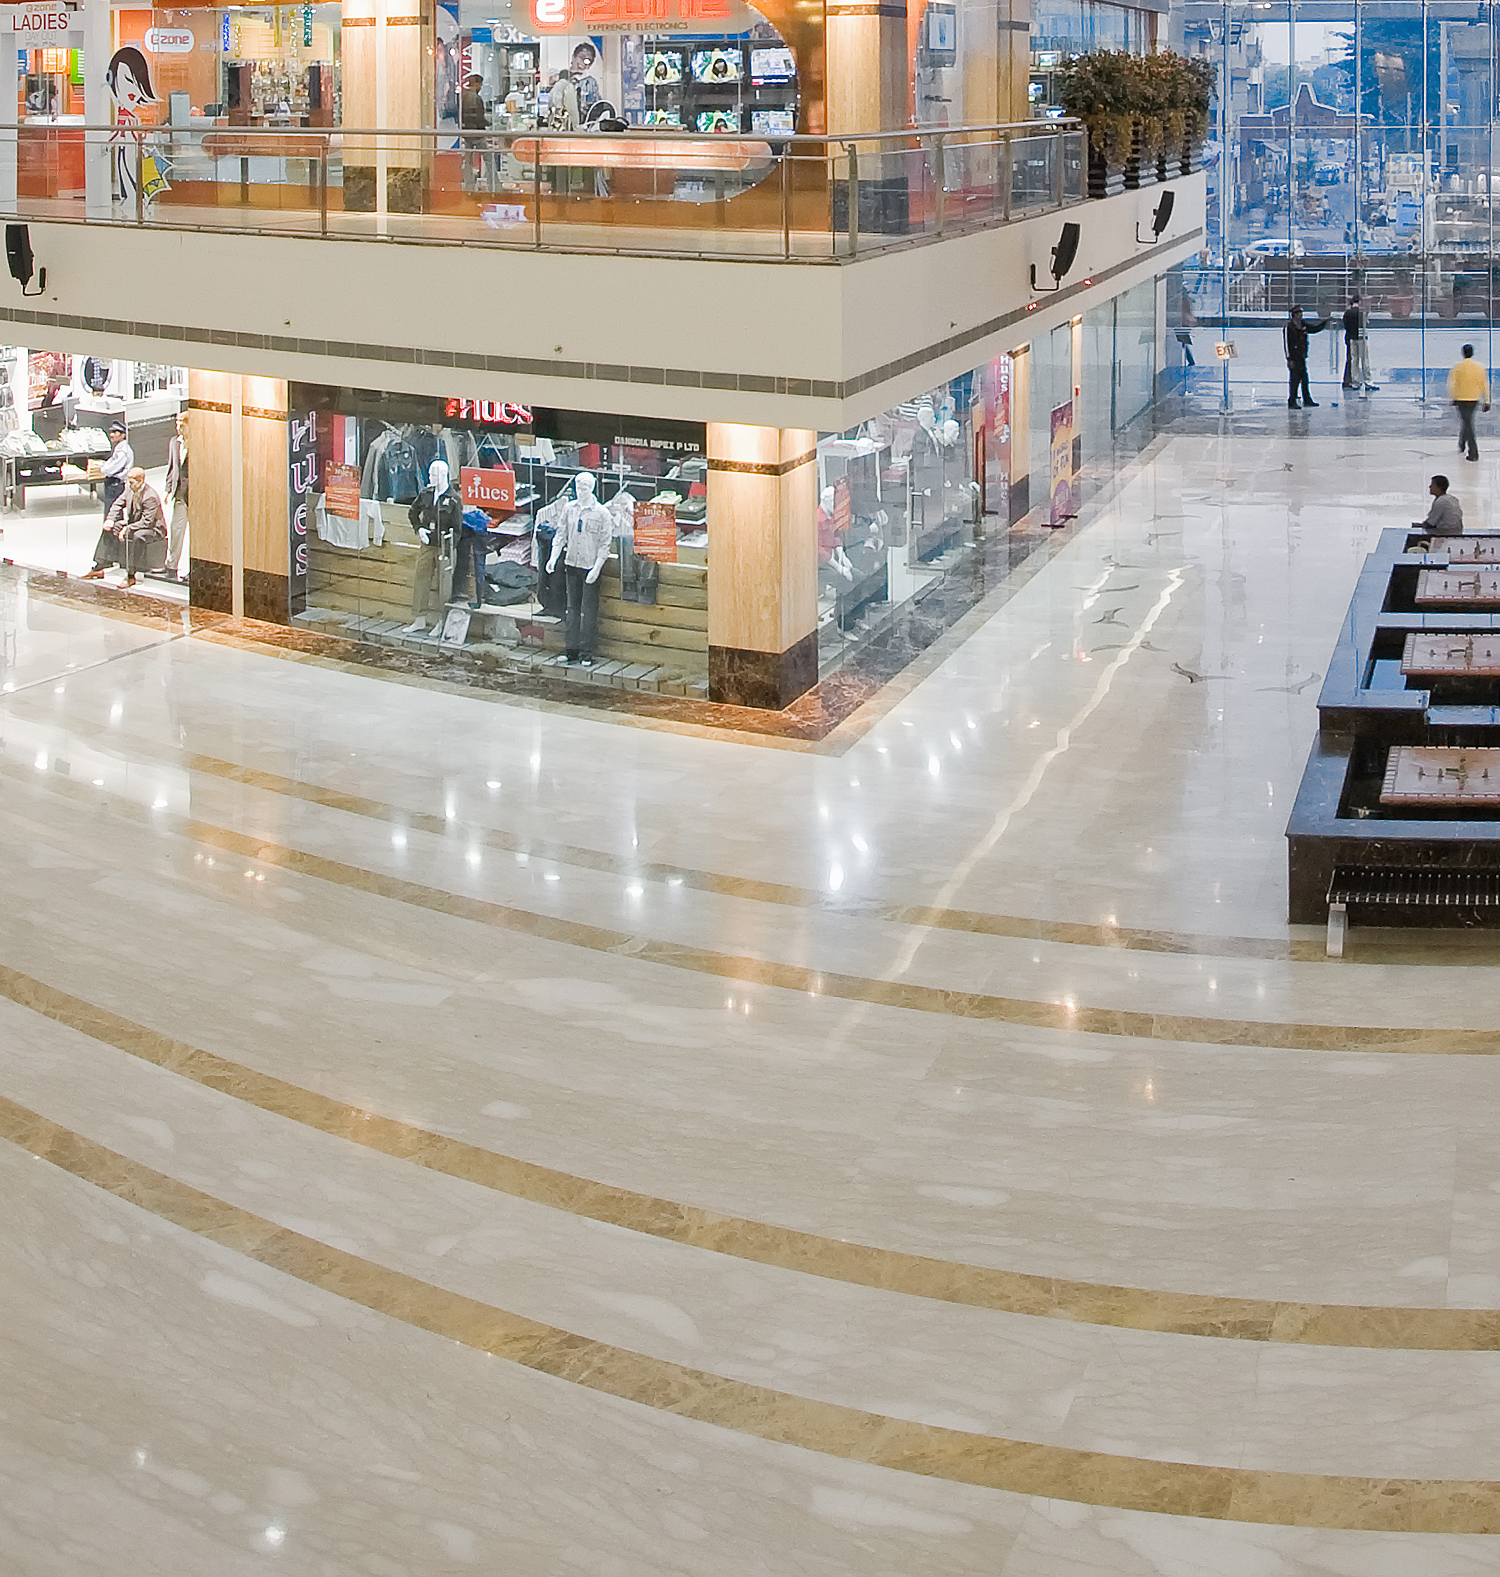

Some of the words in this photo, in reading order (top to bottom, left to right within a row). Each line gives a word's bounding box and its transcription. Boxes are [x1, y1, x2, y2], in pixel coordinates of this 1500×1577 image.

[13, 12, 71, 31] LADIES'
[587, 23, 632, 32] EXPERIENCE
[635, 21, 689, 31] ELECTRONICS
[683, 443, 700, 452] LTD
